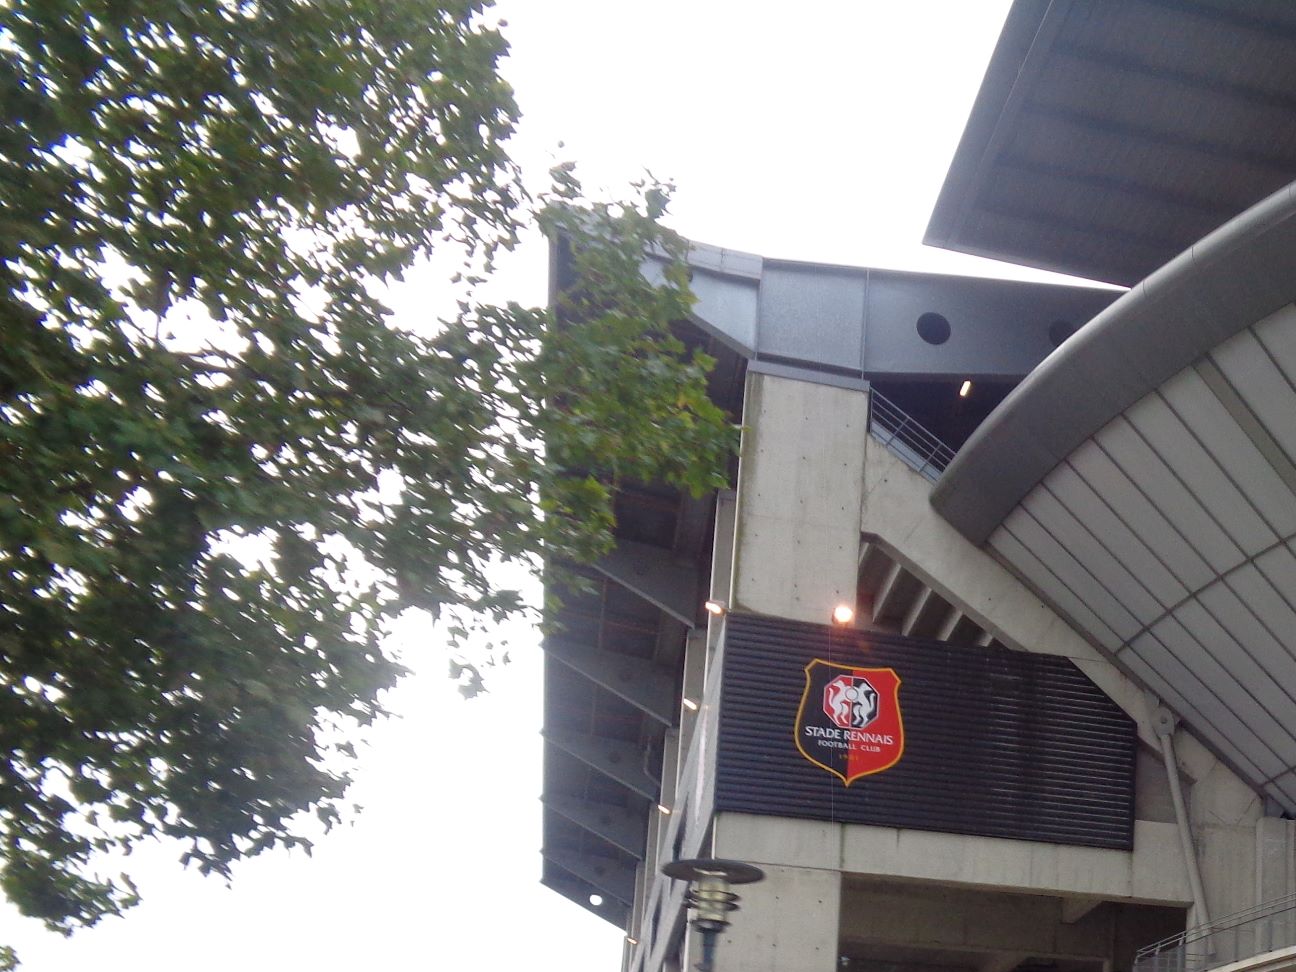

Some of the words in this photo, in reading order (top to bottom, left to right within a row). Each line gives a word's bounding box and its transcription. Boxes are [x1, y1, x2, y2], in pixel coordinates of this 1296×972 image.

[805, 726, 841, 739] STADE
[843, 730, 894, 745] RENNAIS
[819, 740, 856, 750] FOOTBALL
[860, 745, 881, 753] CLUB
